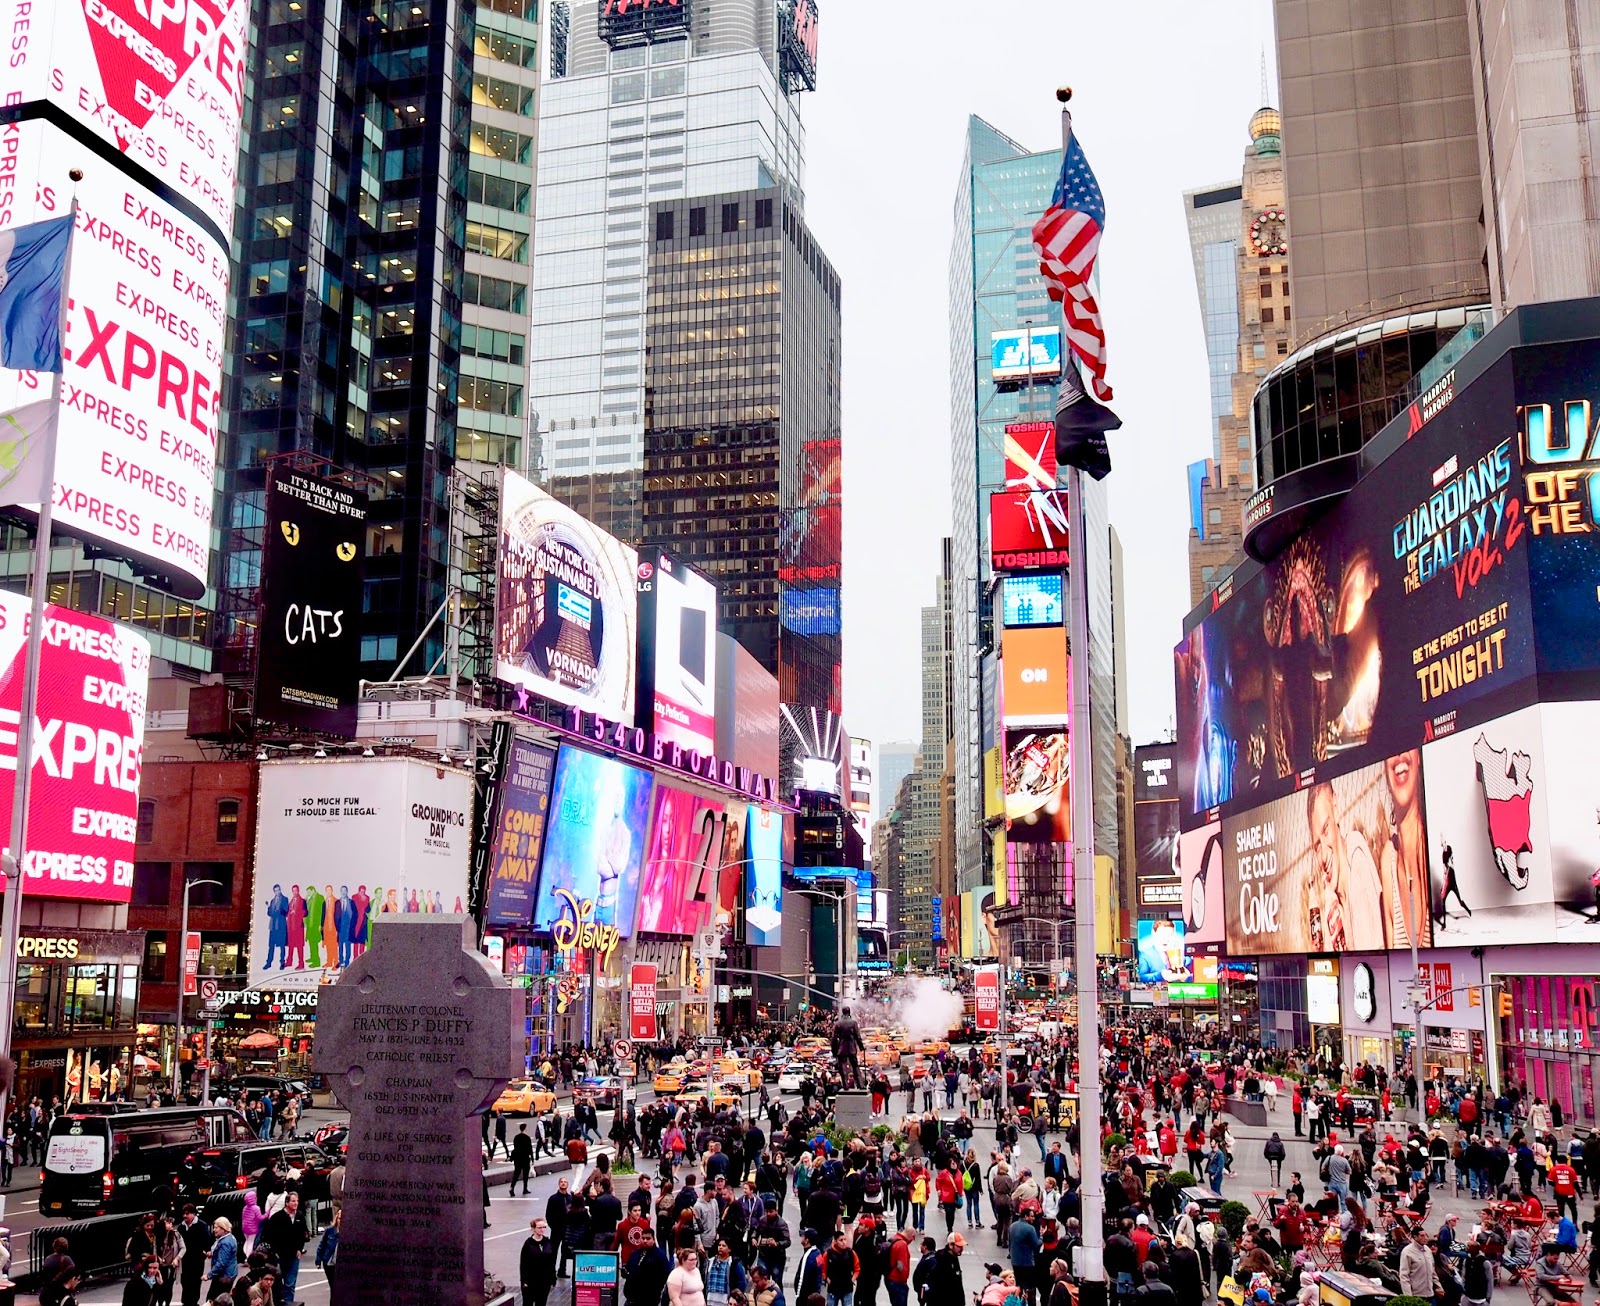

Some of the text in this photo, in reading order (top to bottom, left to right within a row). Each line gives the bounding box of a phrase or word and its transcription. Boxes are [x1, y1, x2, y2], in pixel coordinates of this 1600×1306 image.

[85, 2, 177, 82] EXPRESS
[78, 87, 167, 167] EXPRESS
[136, 79, 214, 159] EXPRESS
[124, 193, 205, 264] EXPRESS
[116, 282, 199, 348] EXPRESS
[1422, 369, 1456, 406] MARRIOTT
[1423, 388, 1453, 422] MARQUIS
[1006, 422, 1054, 433] TOSHIBA
[101, 451, 186, 507] EXPRESS
[291, 475, 353, 505] IT'S BACK AND
[1524, 469, 1584, 504] OF
[313, 494, 338, 510] THAN
[1246, 485, 1275, 511] ARRIOTT
[1393, 436, 1511, 560] GUARDIANS
[1247, 502, 1271, 523] ARQUIS
[1504, 497, 1526, 550] 2
[1406, 488, 1508, 583] OF GALAXY
[508, 533, 592, 595] MOST SUSTAINABLE
[546, 534, 582, 569] NEW YORK
[993, 551, 1069, 567] TOSHIBA
[637, 582, 652, 592] LG
[1404, 570, 1421, 594] THE
[285, 603, 343, 644] CATS
[1413, 602, 1508, 665] BE THE FIRST TO SEE IT
[546, 647, 599, 684] VORNADO
[1021, 668, 1047, 683] ON
[1416, 629, 1506, 702] TONIGHT
[282, 686, 338, 704] CATSBROADWAY.COM
[572, 705, 645, 754] 1540
[1433, 710, 1457, 726] MARRIOTT
[1434, 722, 1455, 736] MARQUIS
[653, 734, 776, 801] BROADWAY
[284, 809, 293, 817] IT
[296, 808, 327, 816] SHOULD
[411, 803, 464, 827] GROUNDHOG
[505, 809, 543, 836] COME
[430, 823, 445, 838] DAY
[1236, 820, 1274, 853] SHARE AN
[432, 839, 450, 849] MUSICAL
[501, 832, 540, 860] FROM
[693, 808, 728, 901] 21
[496, 856, 538, 882] AWAY
[1238, 850, 1277, 882] ICE COLD
[16, 936, 78, 959] XPRESS
[1435, 969, 1450, 985] UNI
[361, 1005, 464, 1016] LIEUTENANT COLONEL
[353, 1018, 408, 1032] FRANCIS
[426, 1020, 473, 1033] DUFFY
[358, 1034, 377, 1043] MAY
[34, 1059, 65, 1068] EXPRESS
[366, 1052, 455, 1062] CATHOLIC PRIEST
[386, 1077, 432, 1087] CHAPLAIN
[375, 1106, 394, 1114] OLD
[374, 1133, 393, 1141] LIFE
[396, 1133, 410, 1142] OF
[413, 1134, 453, 1144] SERVICE
[358, 1152, 455, 1164] GOD AND COUNTRY
[354, 1179, 456, 1191] SPANISH AMERICAN WAR
[434, 1195, 465, 1204] GUARD
